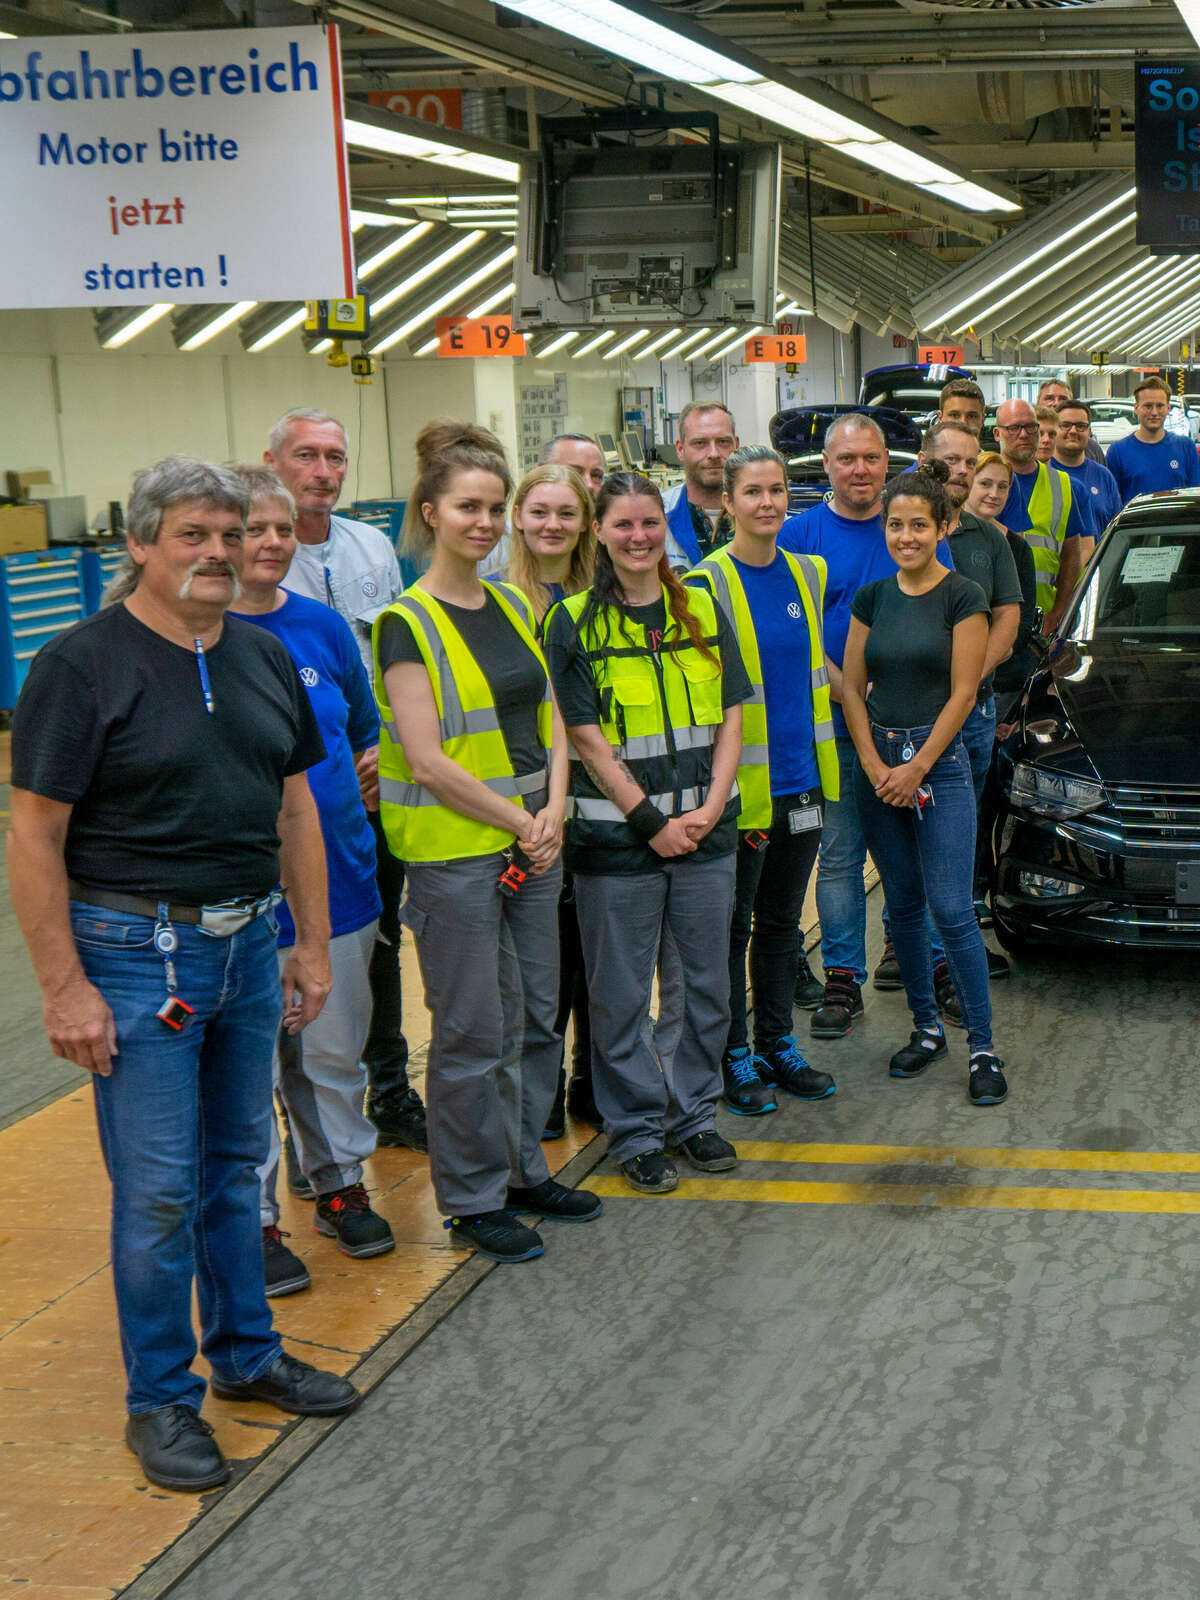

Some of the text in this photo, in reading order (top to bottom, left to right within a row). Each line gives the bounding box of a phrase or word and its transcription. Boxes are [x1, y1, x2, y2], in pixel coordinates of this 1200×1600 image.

[38, 128, 239, 166] Motor bitte
[108, 195, 185, 235] jetzt
[84, 261, 204, 291] starten
[449, 324, 511, 349] E 19
[754, 341, 797, 358] E 18
[926, 351, 957, 364] E 17
